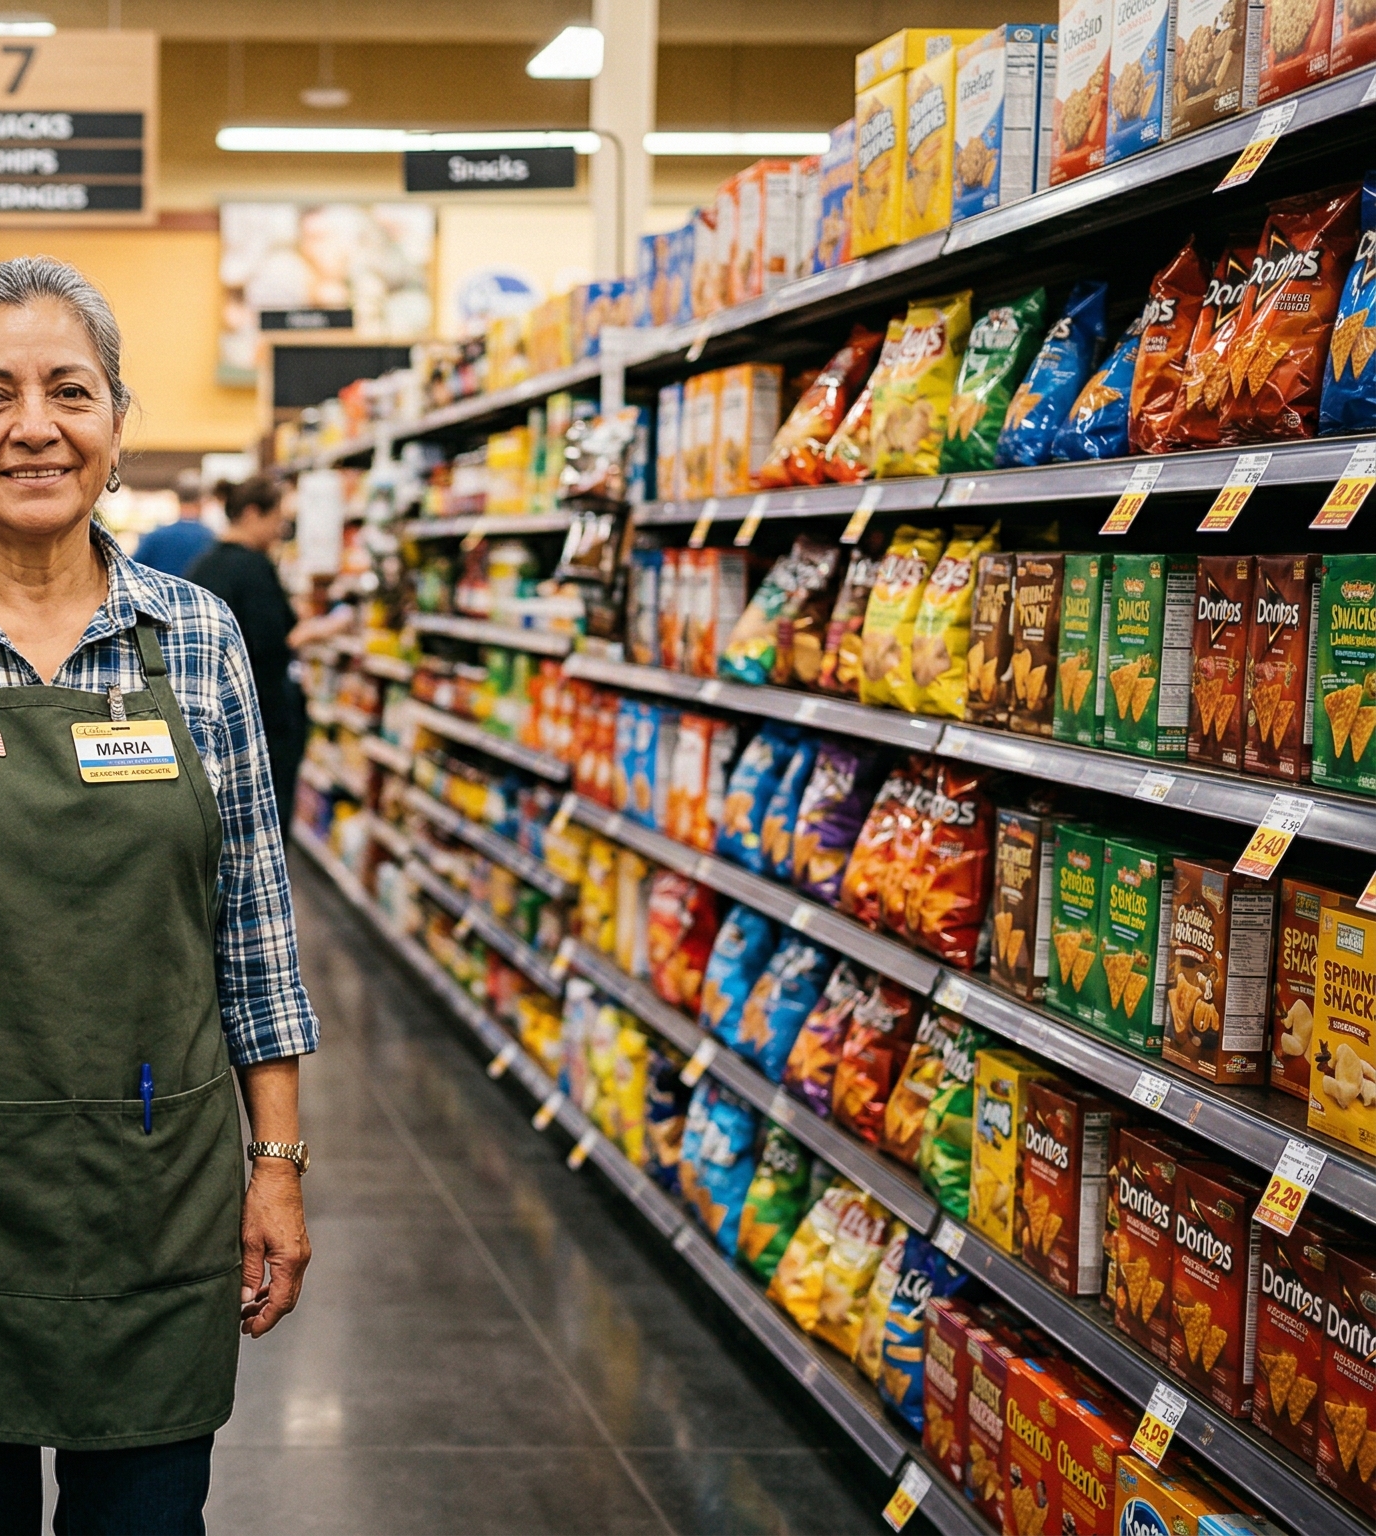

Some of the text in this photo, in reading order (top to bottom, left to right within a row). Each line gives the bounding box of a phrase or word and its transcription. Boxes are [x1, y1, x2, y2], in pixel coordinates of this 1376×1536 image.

[1, 45, 37, 94] 7
[448, 155, 529, 182] Snacks
[1197, 596, 1242, 623] Doritos
[96, 741, 152, 756] MARIA
[1119, 1176, 1170, 1229] Doritos
[1265, 1180, 1302, 1213] 2.20
[1176, 1213, 1233, 1272] Doritos
[1262, 1262, 1323, 1324] Doritos
